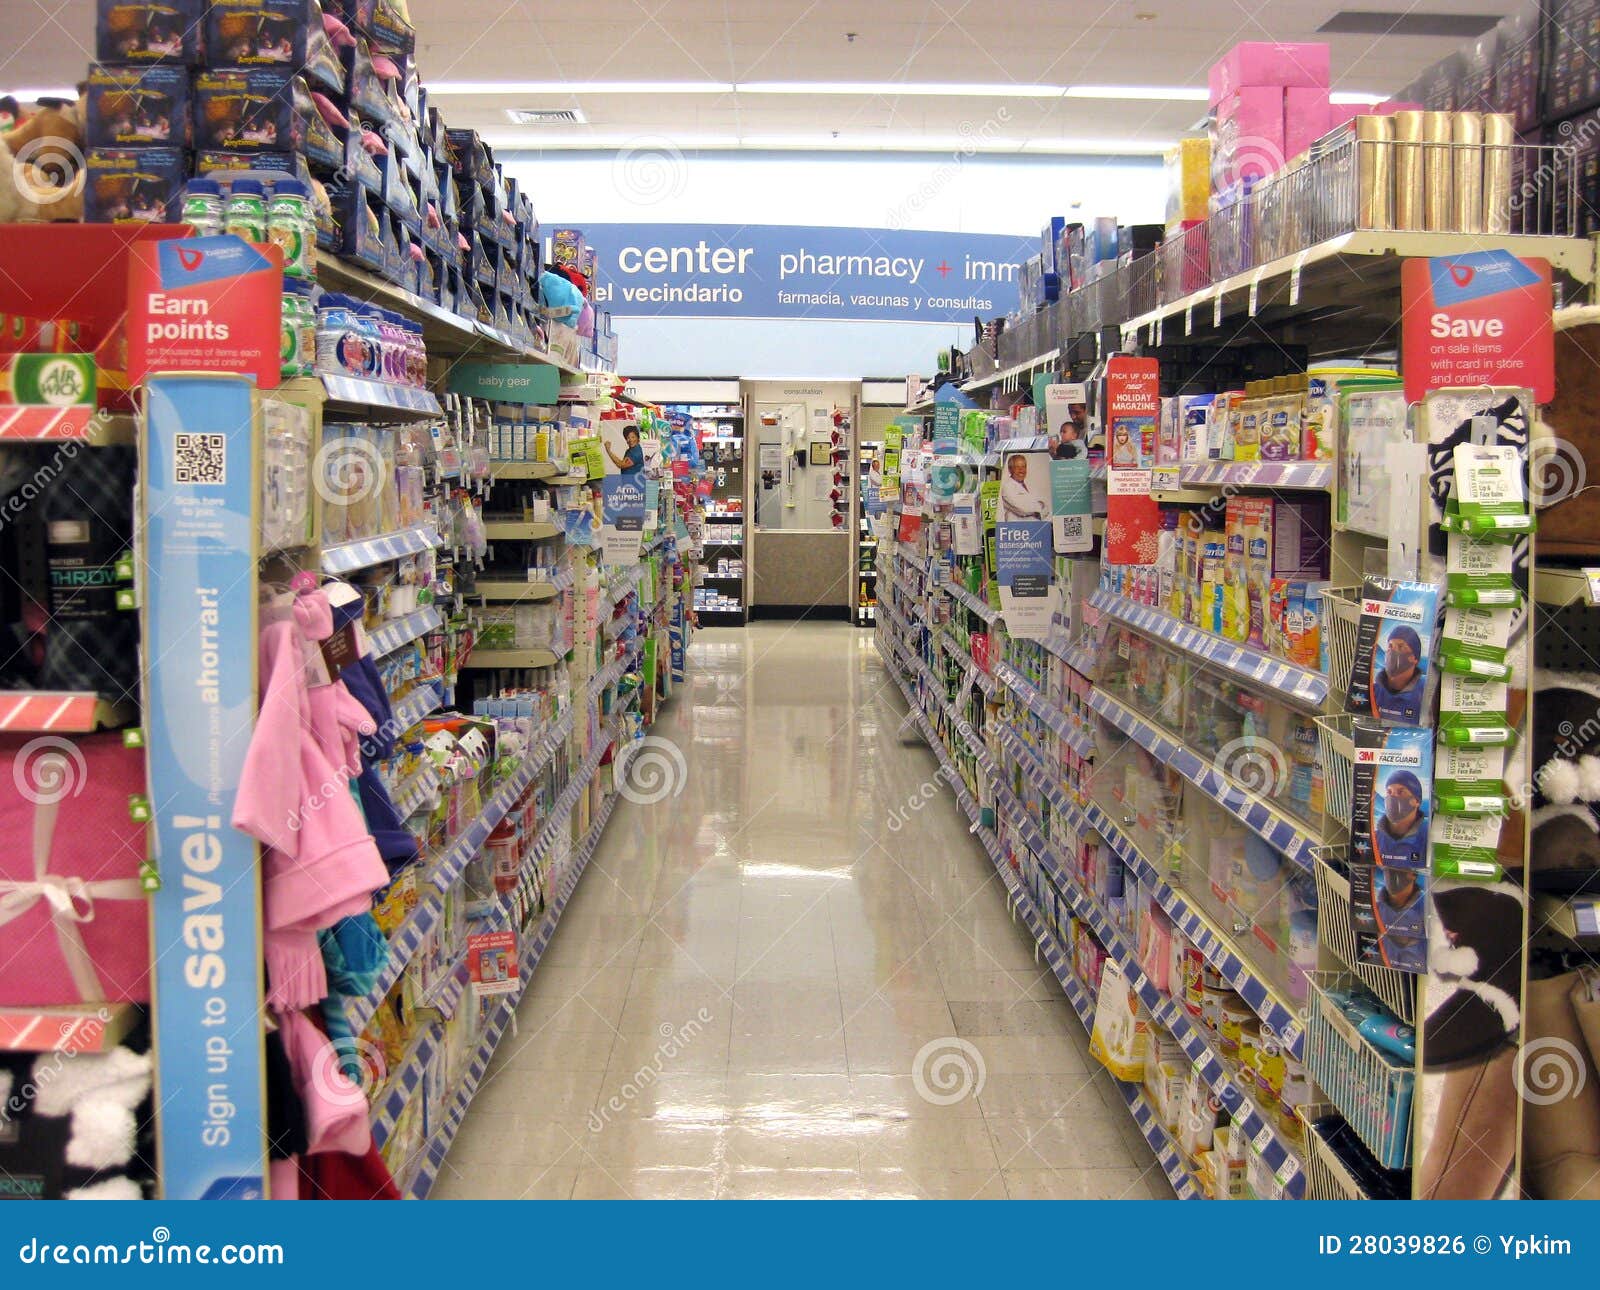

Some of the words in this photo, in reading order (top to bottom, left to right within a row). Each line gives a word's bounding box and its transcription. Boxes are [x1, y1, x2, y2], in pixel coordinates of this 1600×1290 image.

[618, 241, 753, 273] center
[780, 249, 924, 284] pharmacy
[623, 283, 743, 303] vecindario
[148, 293, 208, 315] Earn
[778, 291, 844, 307] farmacia,
[851, 294, 909, 308] vacunas
[914, 296, 923, 311] y
[928, 296, 992, 311] consultas
[147, 319, 230, 343] points
[1430, 313, 1503, 338] Save
[1430, 346, 1444, 354] on
[1447, 344, 1469, 354] sale
[1472, 343, 1502, 353] items
[1430, 359, 1453, 369] with
[1456, 359, 1480, 369] card
[1483, 359, 1493, 369] in
[1496, 359, 1524, 369] store
[478, 376, 504, 388] baby
[506, 378, 531, 389] gear
[1430, 373, 1452, 384] and
[41, 381, 80, 396] WICK
[1116, 394, 1152, 402] HOLIDAY
[1112, 402, 1157, 411] MAGAZINE
[615, 486, 636, 494] Arm
[608, 494, 644, 502] yourself
[1000, 527, 1030, 541] Free
[999, 541, 1043, 550] assessment
[1365, 602, 1380, 614] 3M
[1384, 609, 1400, 617] FACE
[1399, 610, 1422, 620] GUARD
[196, 587, 219, 703] ahorrar!
[1359, 751, 1374, 762] 3M
[1379, 755, 1395, 763] FACE
[1395, 756, 1418, 764] GUARD
[172, 815, 227, 989] save!
[201, 996, 227, 1026] to
[205, 1036, 232, 1074] up
[203, 1084, 236, 1147] Sign
